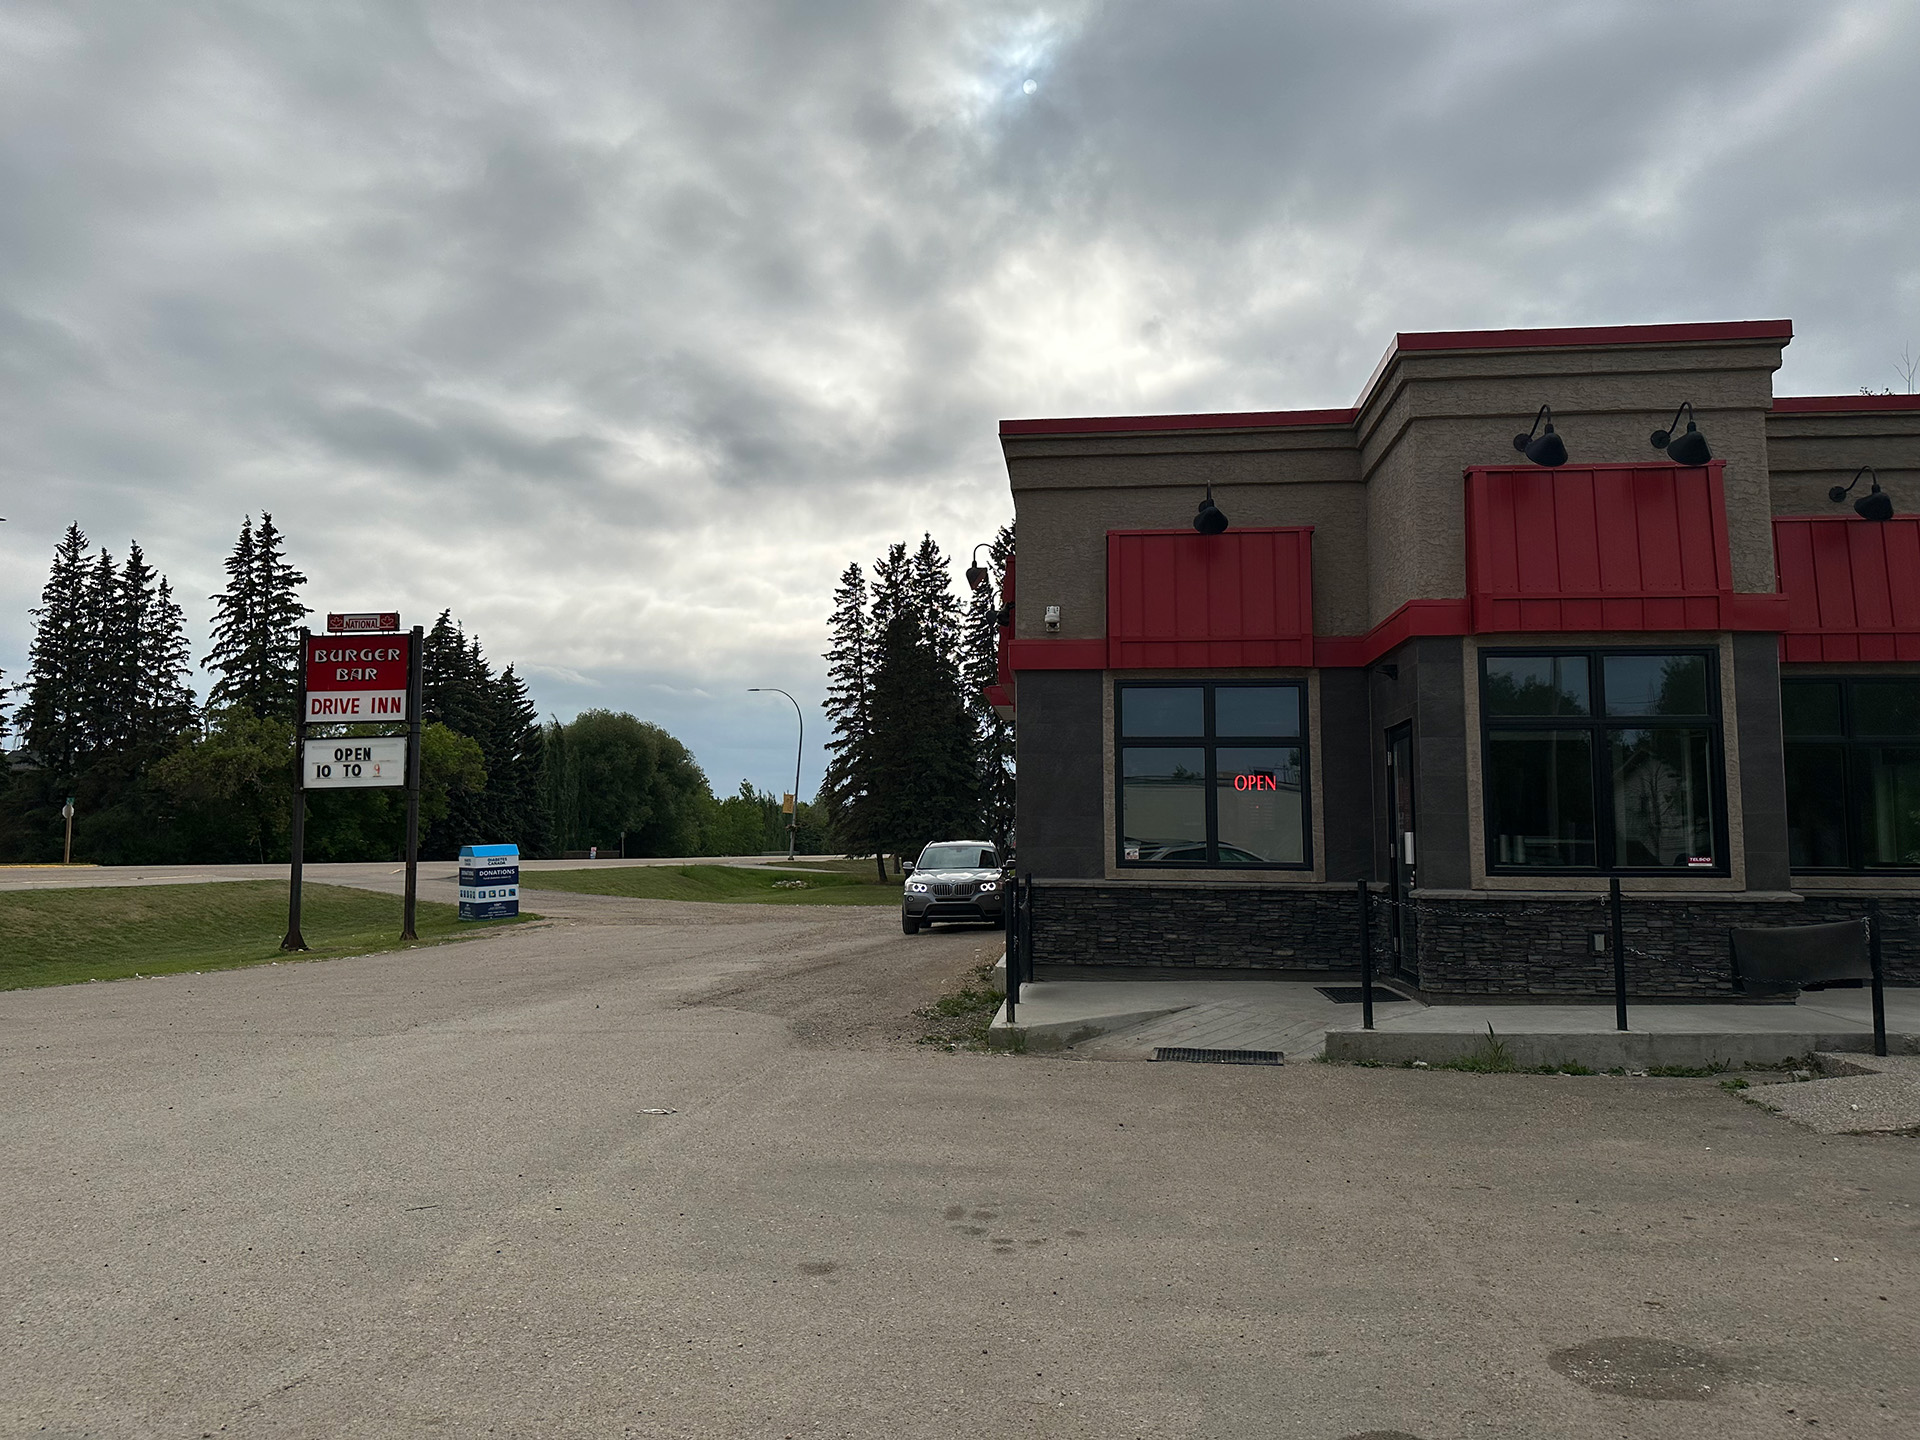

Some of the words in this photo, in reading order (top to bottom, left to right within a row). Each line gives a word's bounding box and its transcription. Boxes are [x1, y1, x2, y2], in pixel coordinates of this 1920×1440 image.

[345, 619, 380, 629] NATIONAL
[314, 648, 400, 662] BURGER
[336, 667, 378, 681] BAR
[311, 698, 360, 715] DRIVE
[371, 697, 402, 714] INN
[334, 747, 372, 761] OPEN
[316, 764, 332, 778] 10
[343, 763, 362, 777] TO
[373, 763, 381, 775] 9
[1234, 774, 1276, 791] OPEN
[479, 868, 515, 876] DONATIONS
